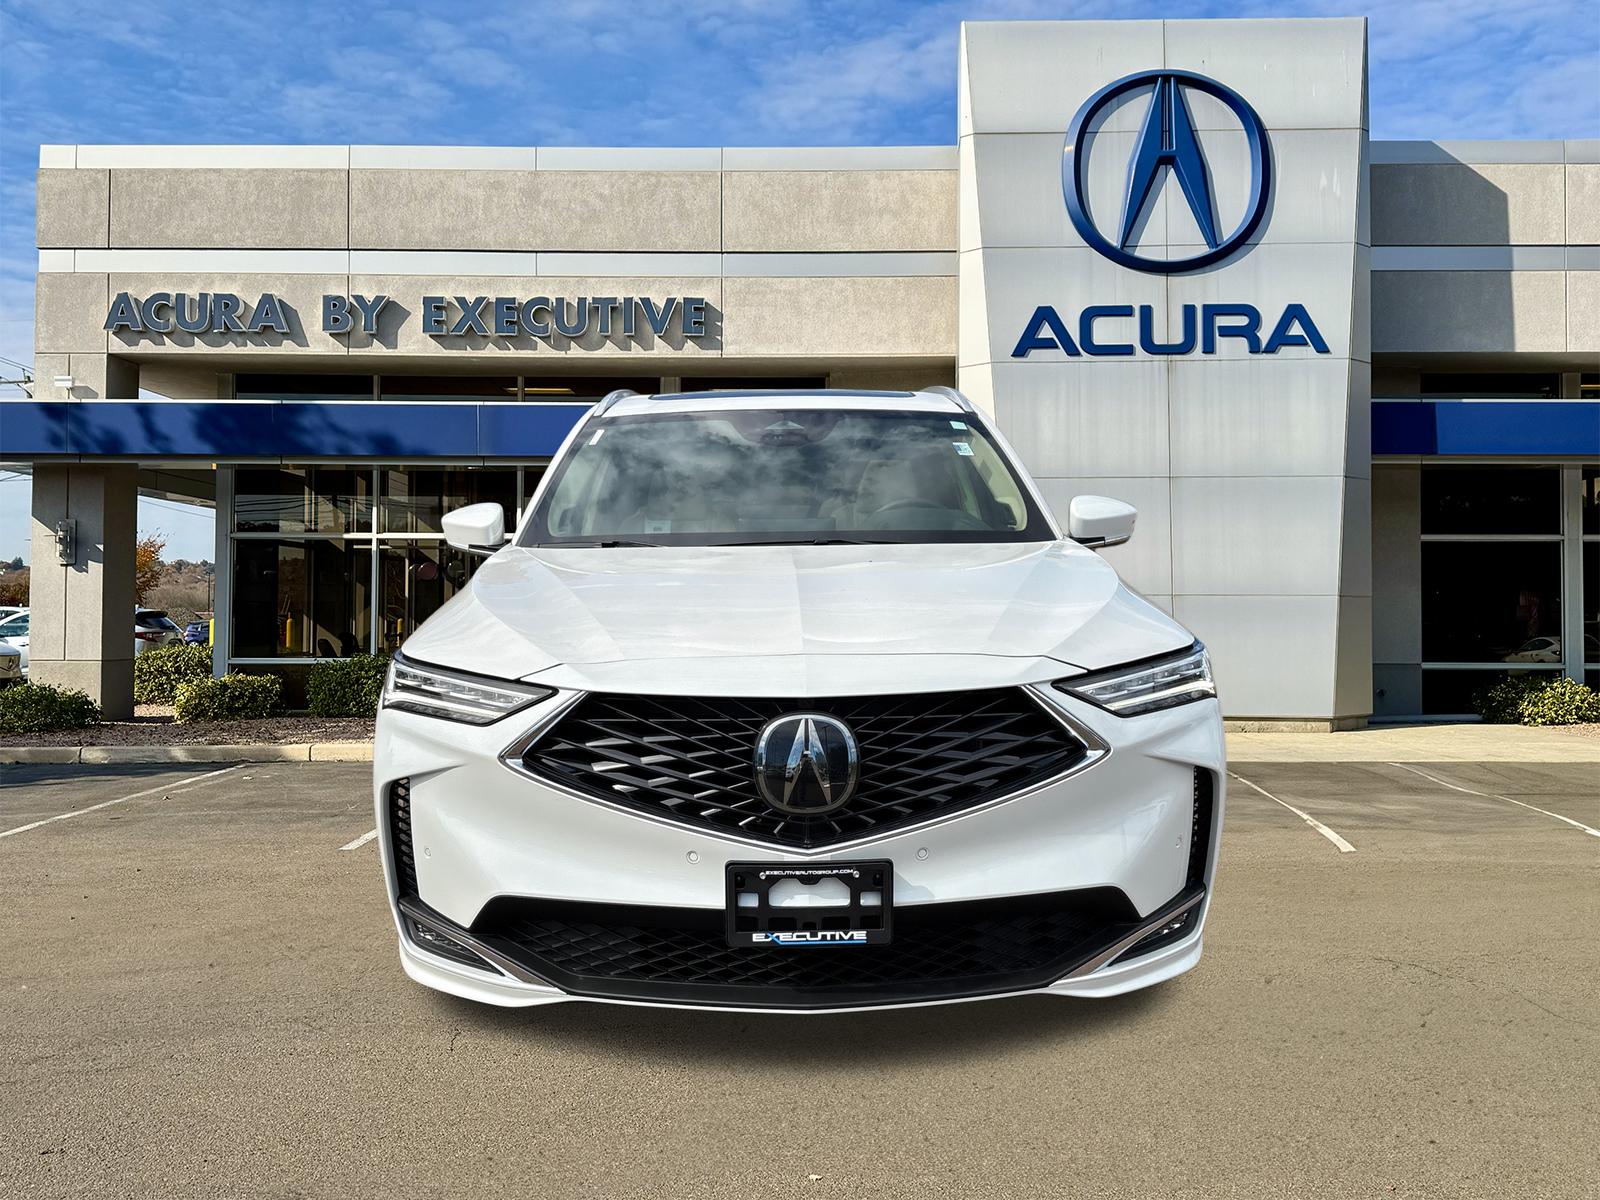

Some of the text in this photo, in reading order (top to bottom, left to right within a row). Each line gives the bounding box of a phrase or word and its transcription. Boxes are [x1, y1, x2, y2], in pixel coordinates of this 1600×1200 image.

[104, 292, 706, 336] ACURA BY EXECUTIVE
[1011, 303, 1331, 357] ACURA
[752, 931, 867, 943] EXECUTIVE
